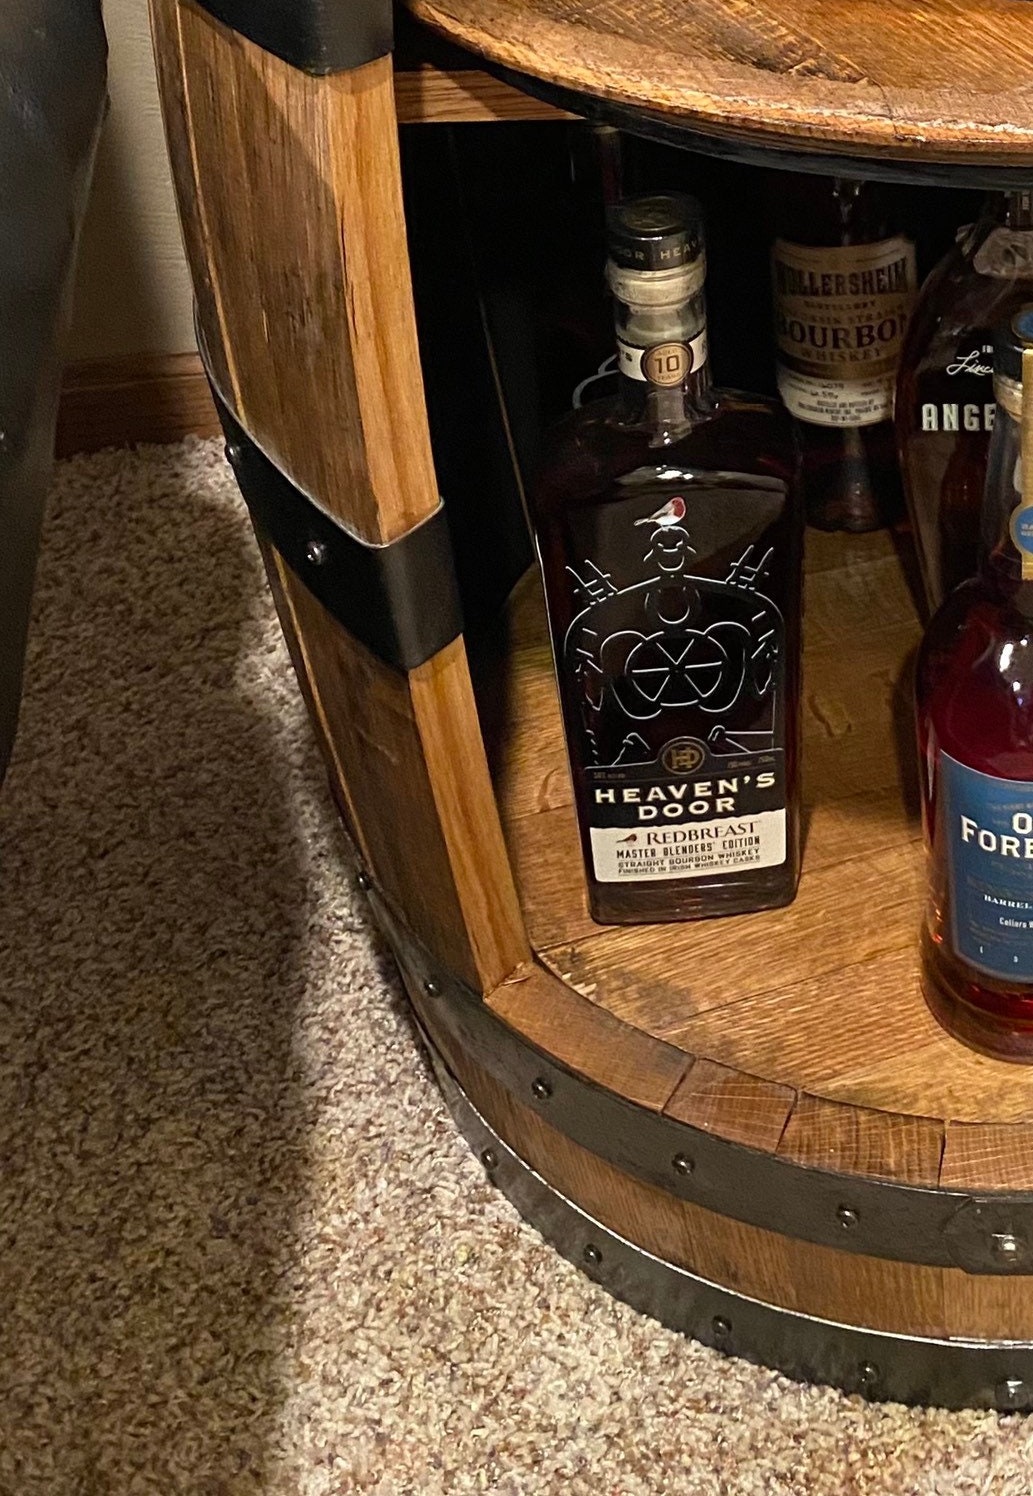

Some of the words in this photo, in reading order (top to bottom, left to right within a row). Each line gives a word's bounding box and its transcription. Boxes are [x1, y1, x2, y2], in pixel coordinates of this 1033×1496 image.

[654, 354, 680, 375] 10
[945, 349, 994, 377] Linc
[920, 402, 995, 433] ANGE
[594, 771, 777, 804] HEAVEN'S
[637, 796, 737, 821] DOOR
[646, 821, 759, 846] REDBREAST
[616, 848, 656, 859] MASTER
[722, 835, 760, 850] EDITION
[618, 858, 665, 869] STRAIGHT
[668, 854, 715, 866] BOURBON
[717, 847, 761, 860] WHISKEY
[618, 866, 656, 875] FINISHED
[658, 865, 667, 873] IN
[694, 858, 731, 869] WHISKEY
[983, 893, 1033, 910] BARREL
